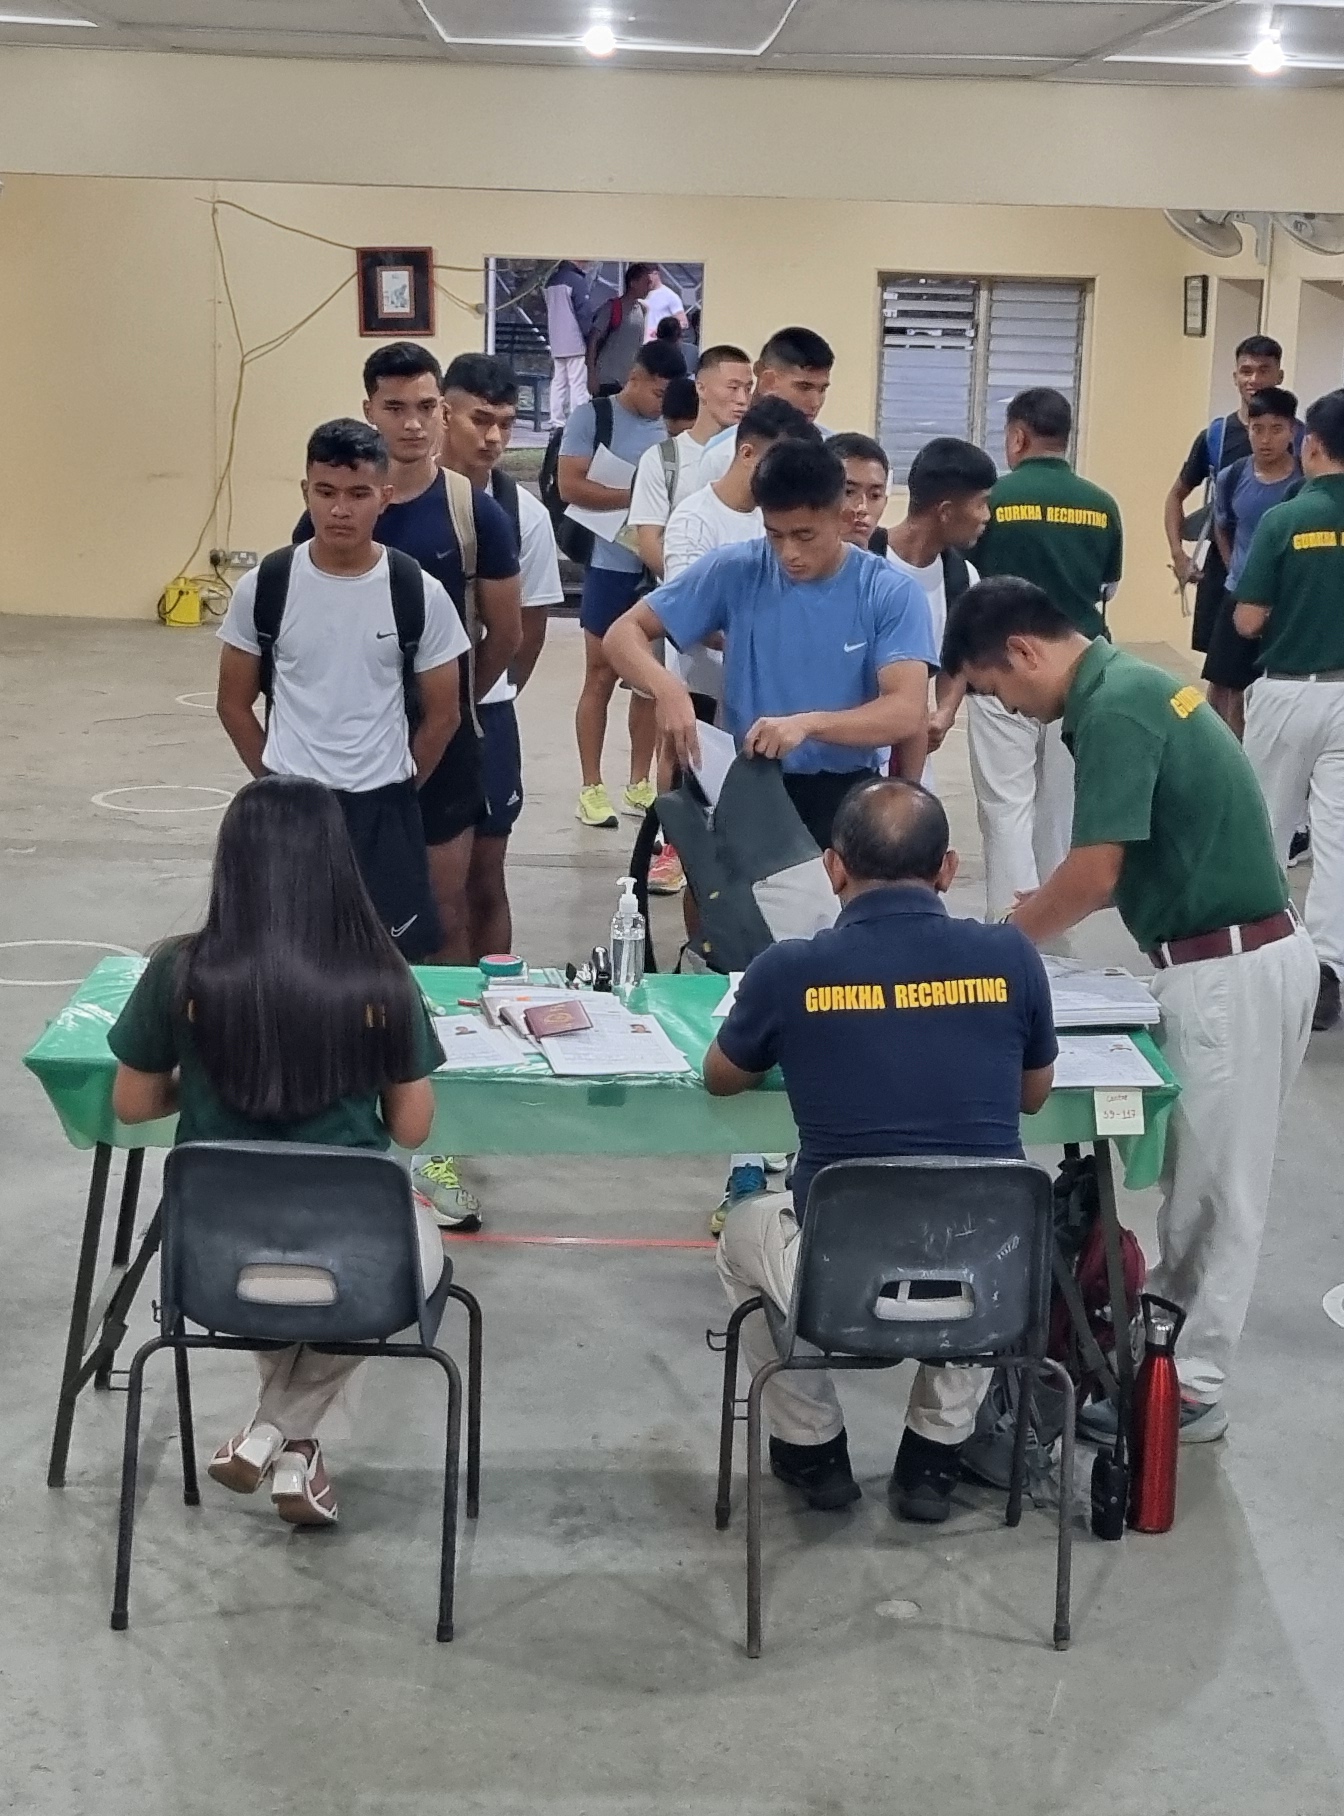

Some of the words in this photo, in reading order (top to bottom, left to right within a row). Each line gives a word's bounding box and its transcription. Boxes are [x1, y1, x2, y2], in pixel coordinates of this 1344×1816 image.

[995, 504, 1043, 523] GURKHA
[1045, 506, 1108, 529] RECRUITING
[805, 985, 886, 1012] GURKHA
[894, 977, 1008, 1009] RECRUITING
